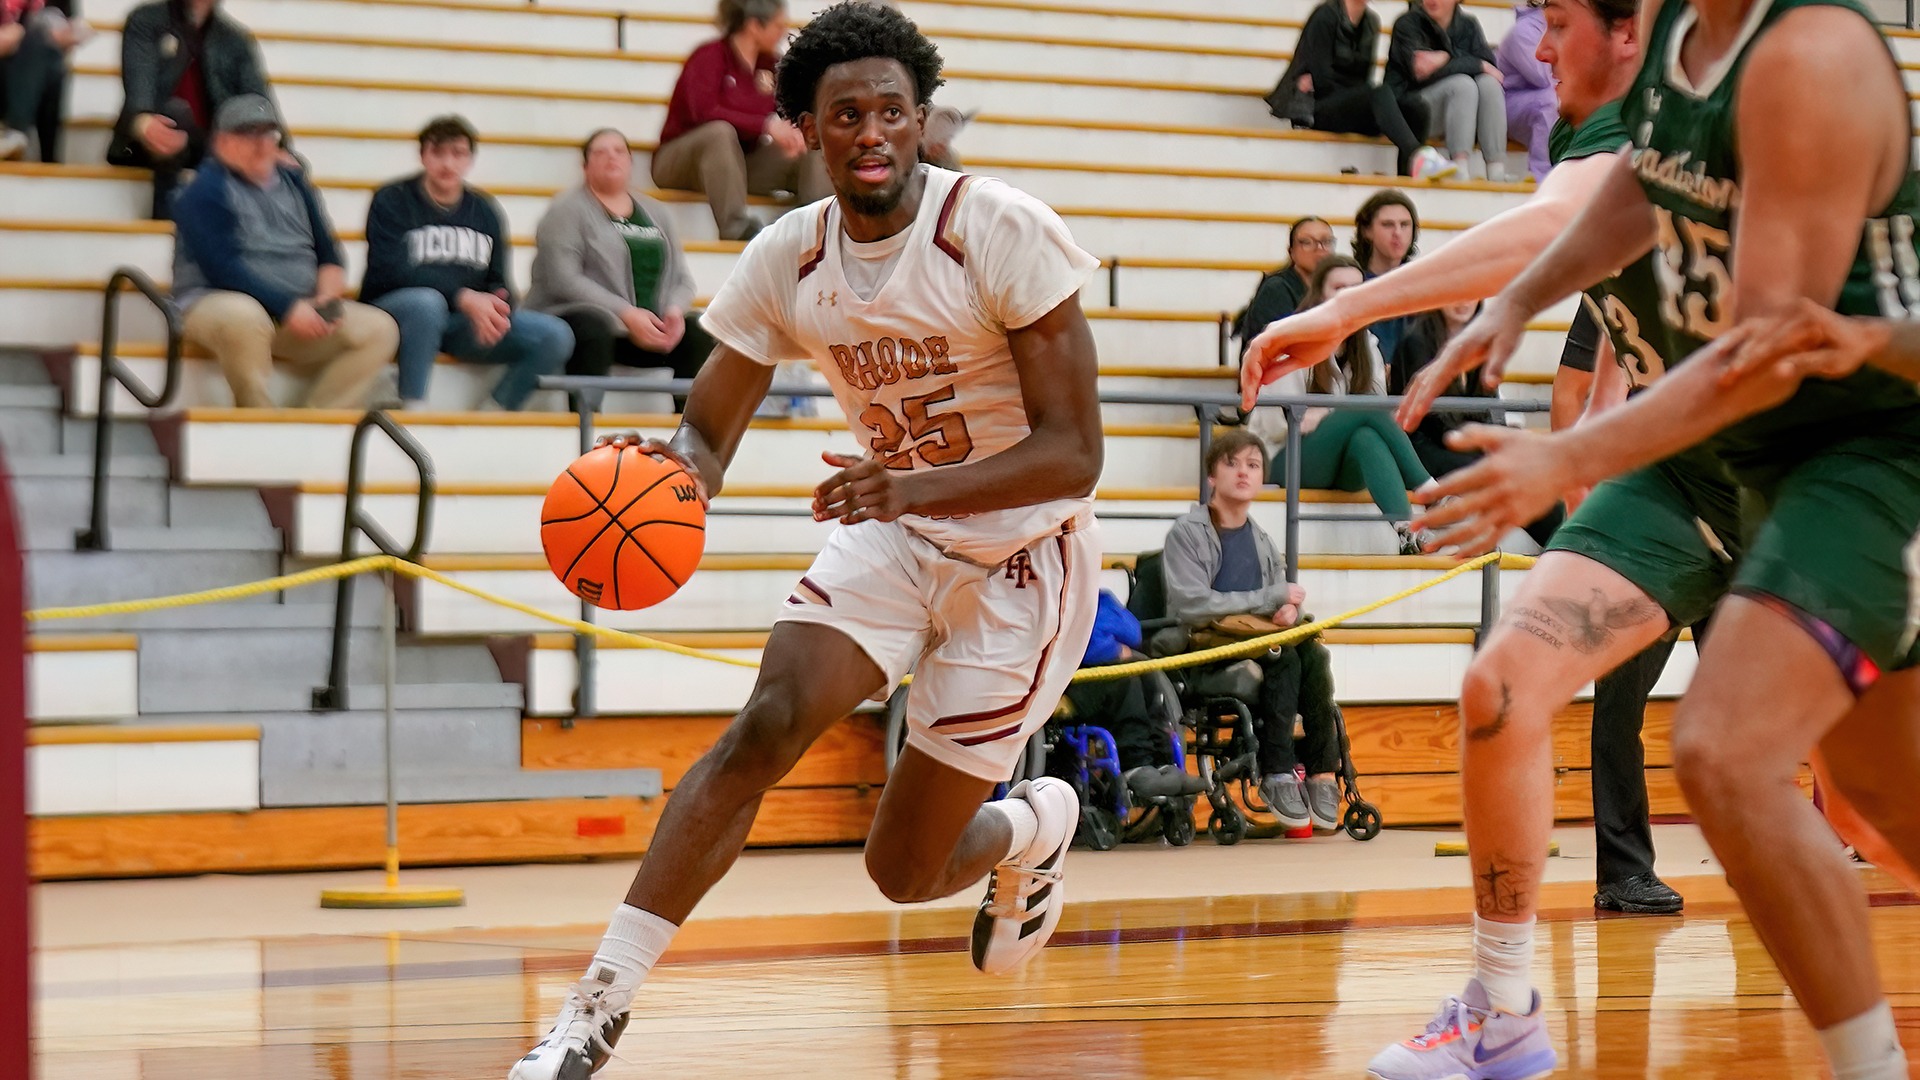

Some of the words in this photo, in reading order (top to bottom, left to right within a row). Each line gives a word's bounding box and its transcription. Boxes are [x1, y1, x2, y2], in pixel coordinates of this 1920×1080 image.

[1653, 204, 1733, 341] 15
[829, 336, 958, 390] RHODE
[860, 384, 974, 470] 25
